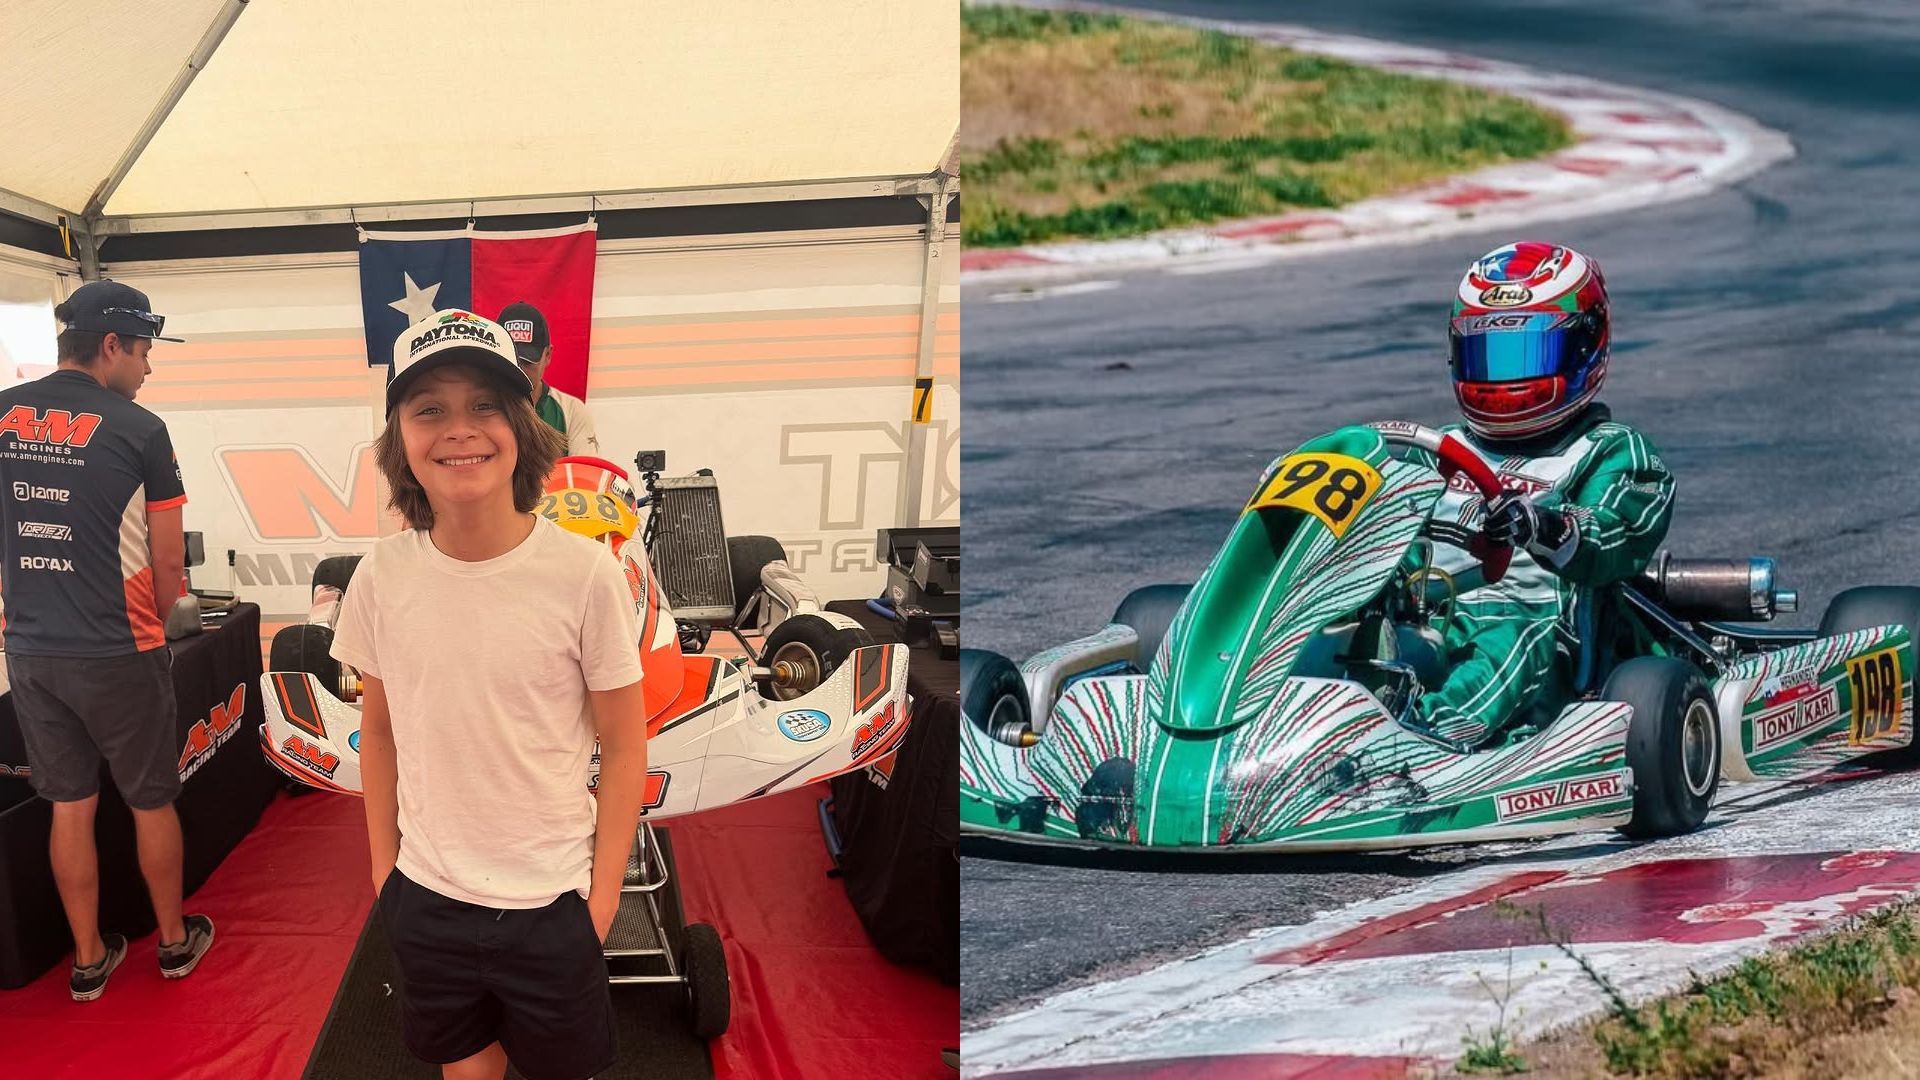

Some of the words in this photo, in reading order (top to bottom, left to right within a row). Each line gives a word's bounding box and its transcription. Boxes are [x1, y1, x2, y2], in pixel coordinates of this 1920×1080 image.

[1486, 286, 1527, 301] Arai
[410, 323, 497, 352] DAYTONA
[506, 322, 530, 332] LIQUI
[409, 335, 461, 358] INTERNATIONAL
[462, 335, 497, 349] SPEEDWAY
[915, 378, 933, 422] 7
[9, 442, 72, 455] ENGINES
[1250, 459, 1367, 521] 198
[540, 491, 620, 520] 298
[18, 521, 69, 540] VORTEX
[20, 556, 75, 572] ROTAX
[1852, 652, 1896, 741] 198
[790, 718, 822, 737] SKUSA
[1757, 707, 1796, 740] TONY
[1803, 687, 1835, 722] KART
[179, 744, 217, 784] RACING
[217, 717, 242, 749] TEAM
[851, 734, 879, 760] RACING
[281, 747, 309, 767] RACING
[308, 761, 333, 779] TEAM
[1500, 786, 1557, 813] TONY
[1569, 774, 1622, 799] KART
